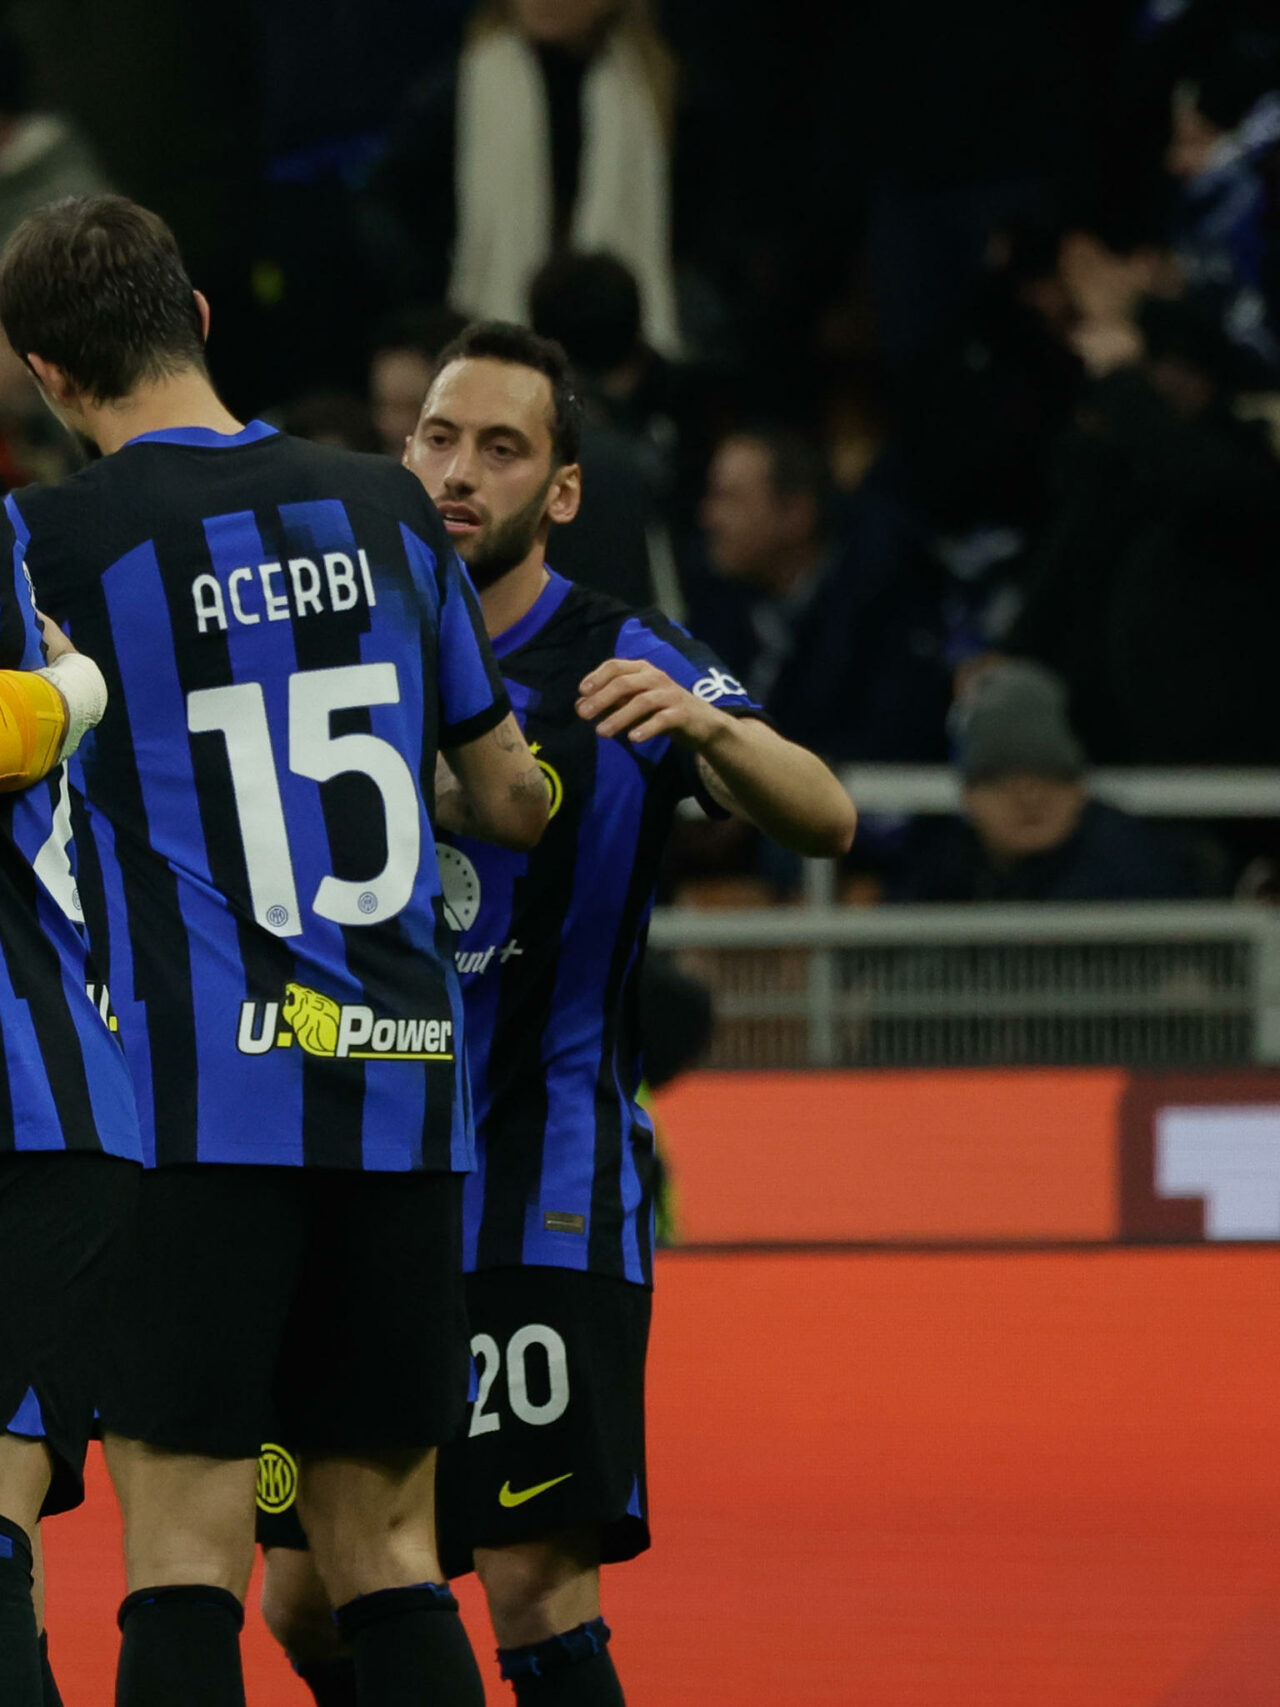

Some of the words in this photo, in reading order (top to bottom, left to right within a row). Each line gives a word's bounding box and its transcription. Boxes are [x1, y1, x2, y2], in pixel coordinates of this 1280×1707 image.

[192, 549, 377, 633] ACERBI
[187, 662, 420, 937] 15
[468, 1323, 570, 1438] 20
